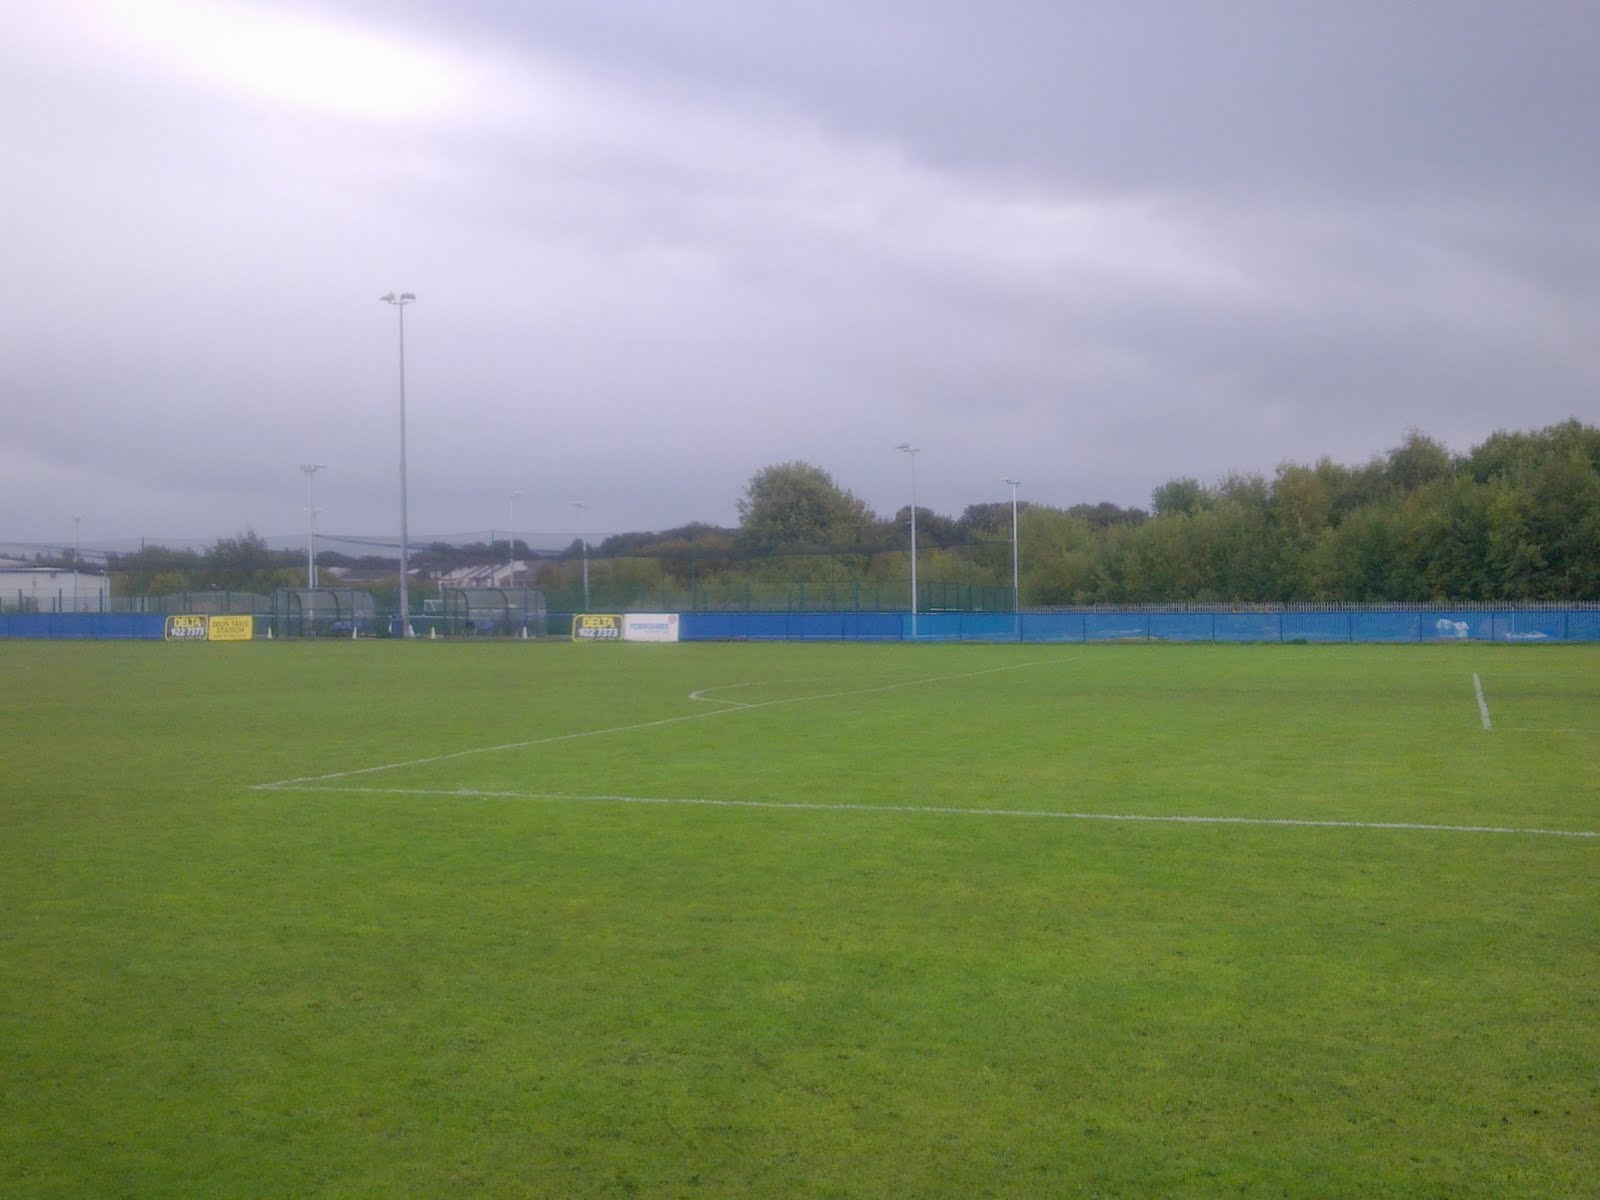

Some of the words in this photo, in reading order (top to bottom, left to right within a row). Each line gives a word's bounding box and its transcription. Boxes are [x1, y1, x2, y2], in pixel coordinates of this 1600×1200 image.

[174, 617, 201, 628] DELTA
[582, 617, 615, 628] DELTA
[171, 628, 186, 636] 922
[186, 628, 204, 636] 7373
[578, 628, 595, 637] 922
[596, 628, 618, 637] 7373
